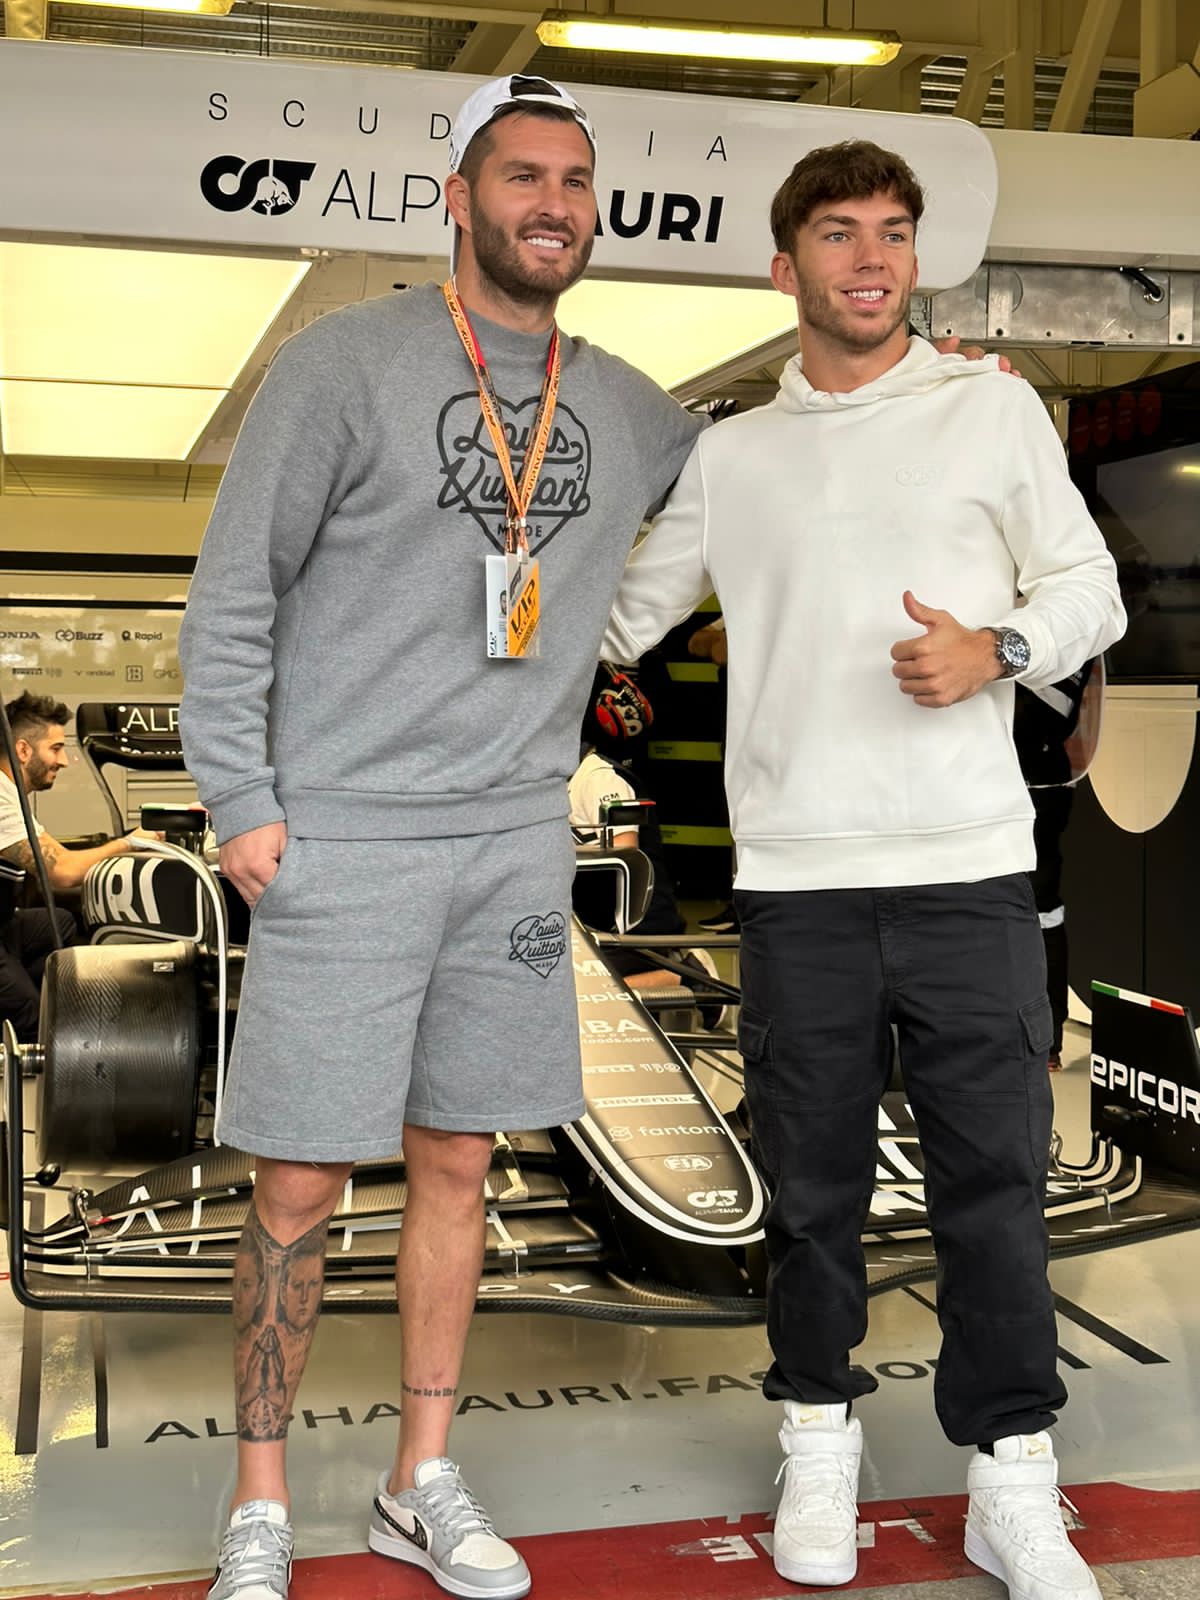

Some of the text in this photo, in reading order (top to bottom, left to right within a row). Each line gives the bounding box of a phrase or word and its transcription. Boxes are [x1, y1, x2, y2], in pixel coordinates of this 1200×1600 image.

[208, 92, 729, 161] SCUDIA
[498, 524, 542, 537] MDE
[0, 631, 41, 640] ONDA
[135, 632, 163, 642] Rapid
[638, 1125, 726, 1137] fantom
